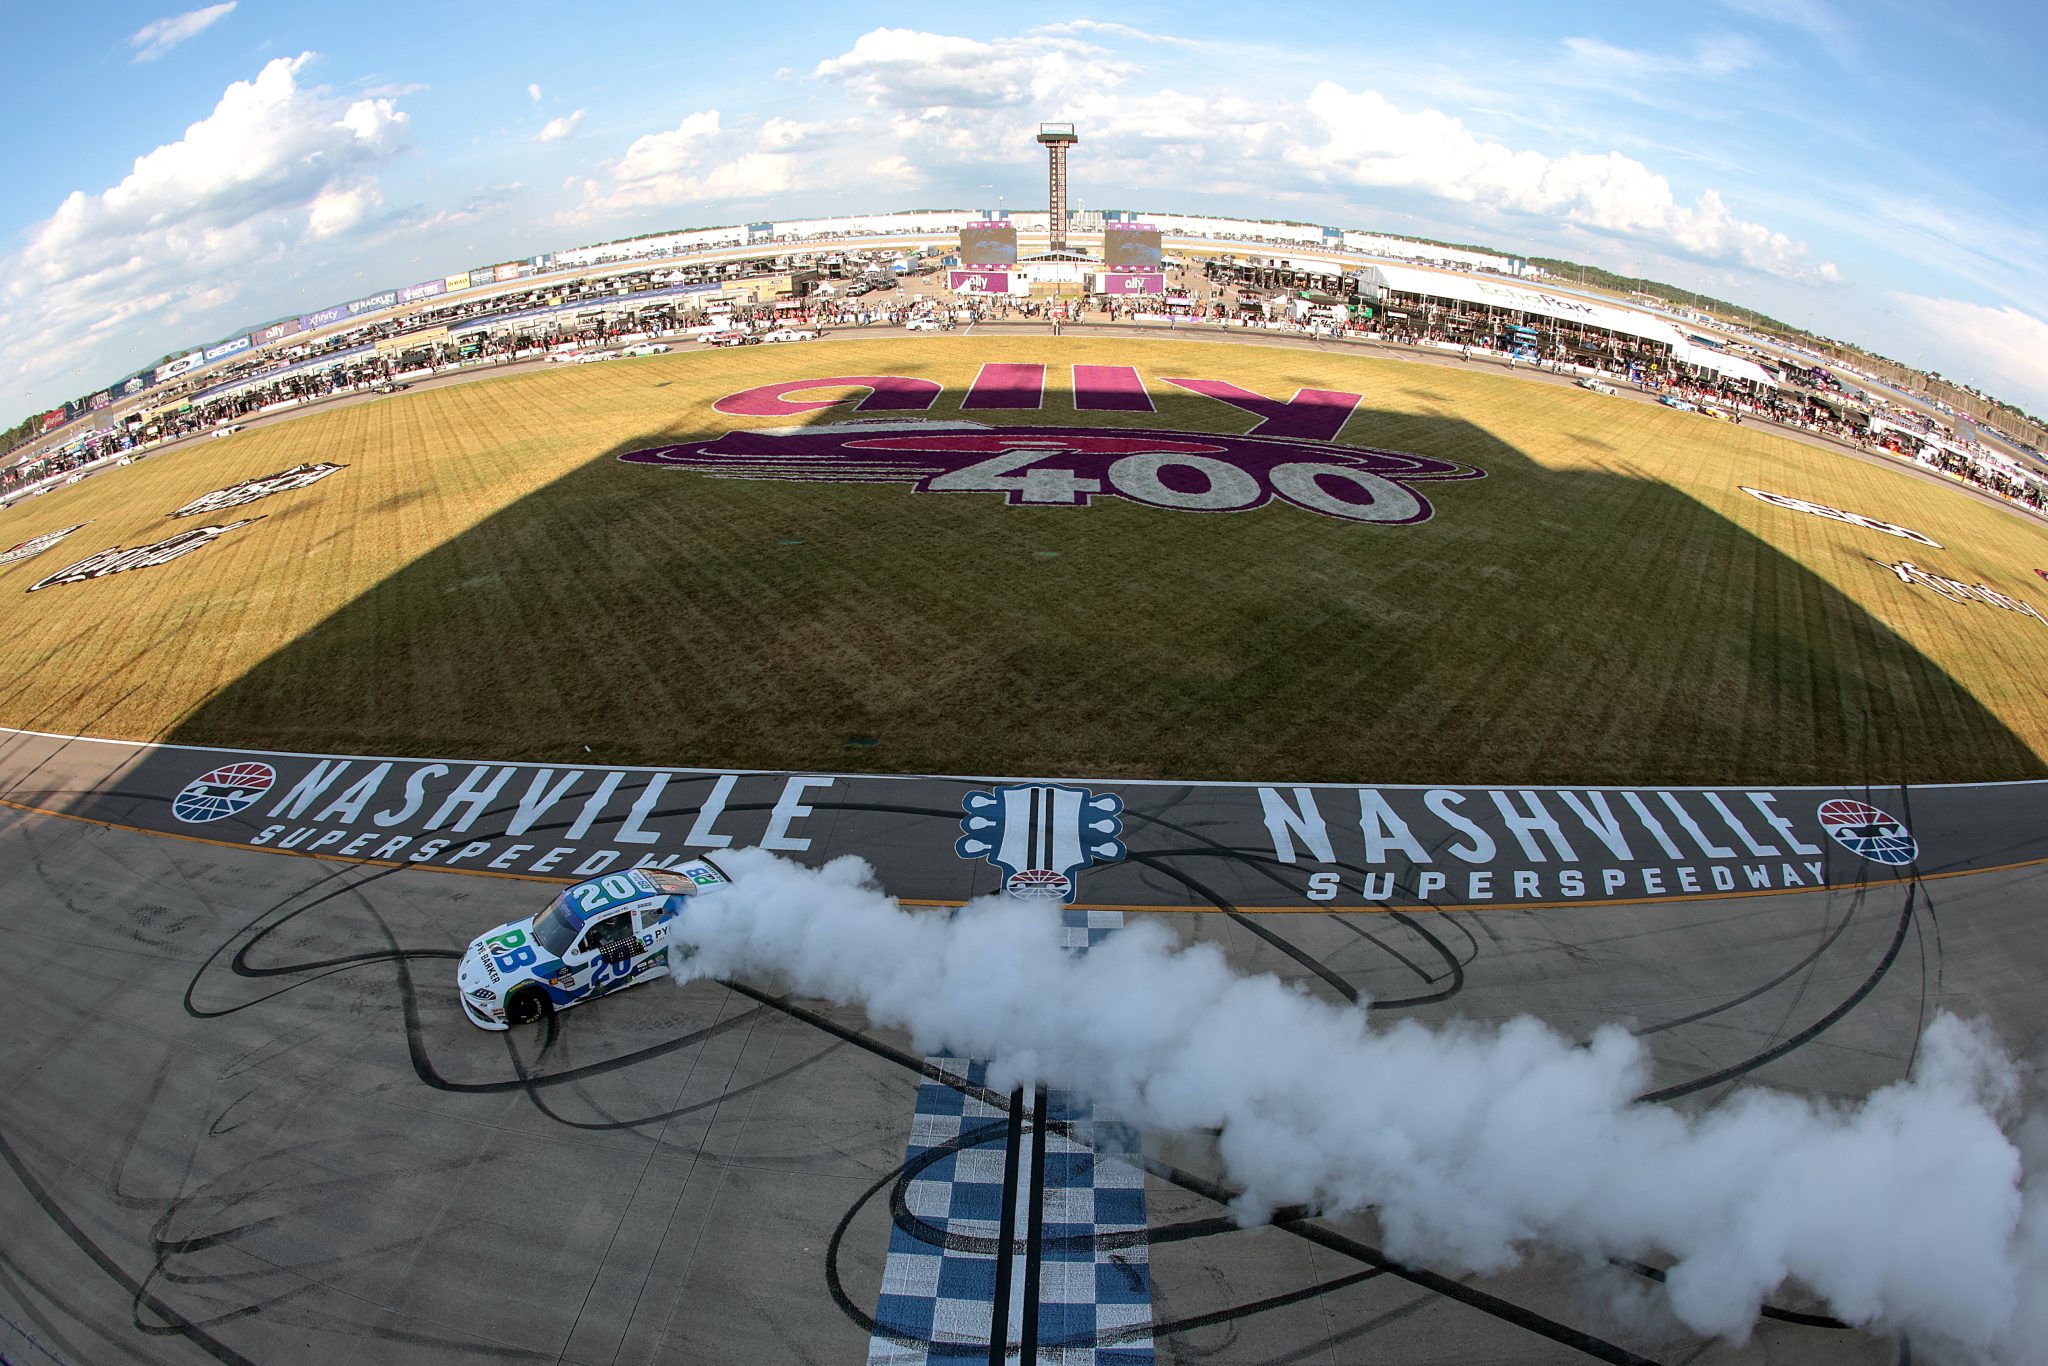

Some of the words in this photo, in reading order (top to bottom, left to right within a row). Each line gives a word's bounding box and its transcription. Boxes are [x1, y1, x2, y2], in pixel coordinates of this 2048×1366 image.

[360, 293, 396, 308] RACKLEY
[968, 275, 988, 290] ally
[1125, 276, 1144, 293] ally
[1476, 282, 1598, 316] EchoPark
[266, 325, 285, 340] ally
[309, 310, 339, 327] xfinity
[206, 337, 249, 360] GEICO
[712, 362, 1366, 441] ally
[926, 447, 1426, 523] 400
[1739, 486, 1945, 549] GEICO
[1869, 559, 2048, 628] xfinity
[266, 760, 835, 850] NASHVILLE
[1257, 787, 1823, 864] NASHVILLE
[250, 824, 681, 876] SUPERSPEEDW
[573, 874, 638, 914] 20
[1306, 861, 1825, 901] SUPERSPEEDWAY
[589, 952, 632, 987] 20
